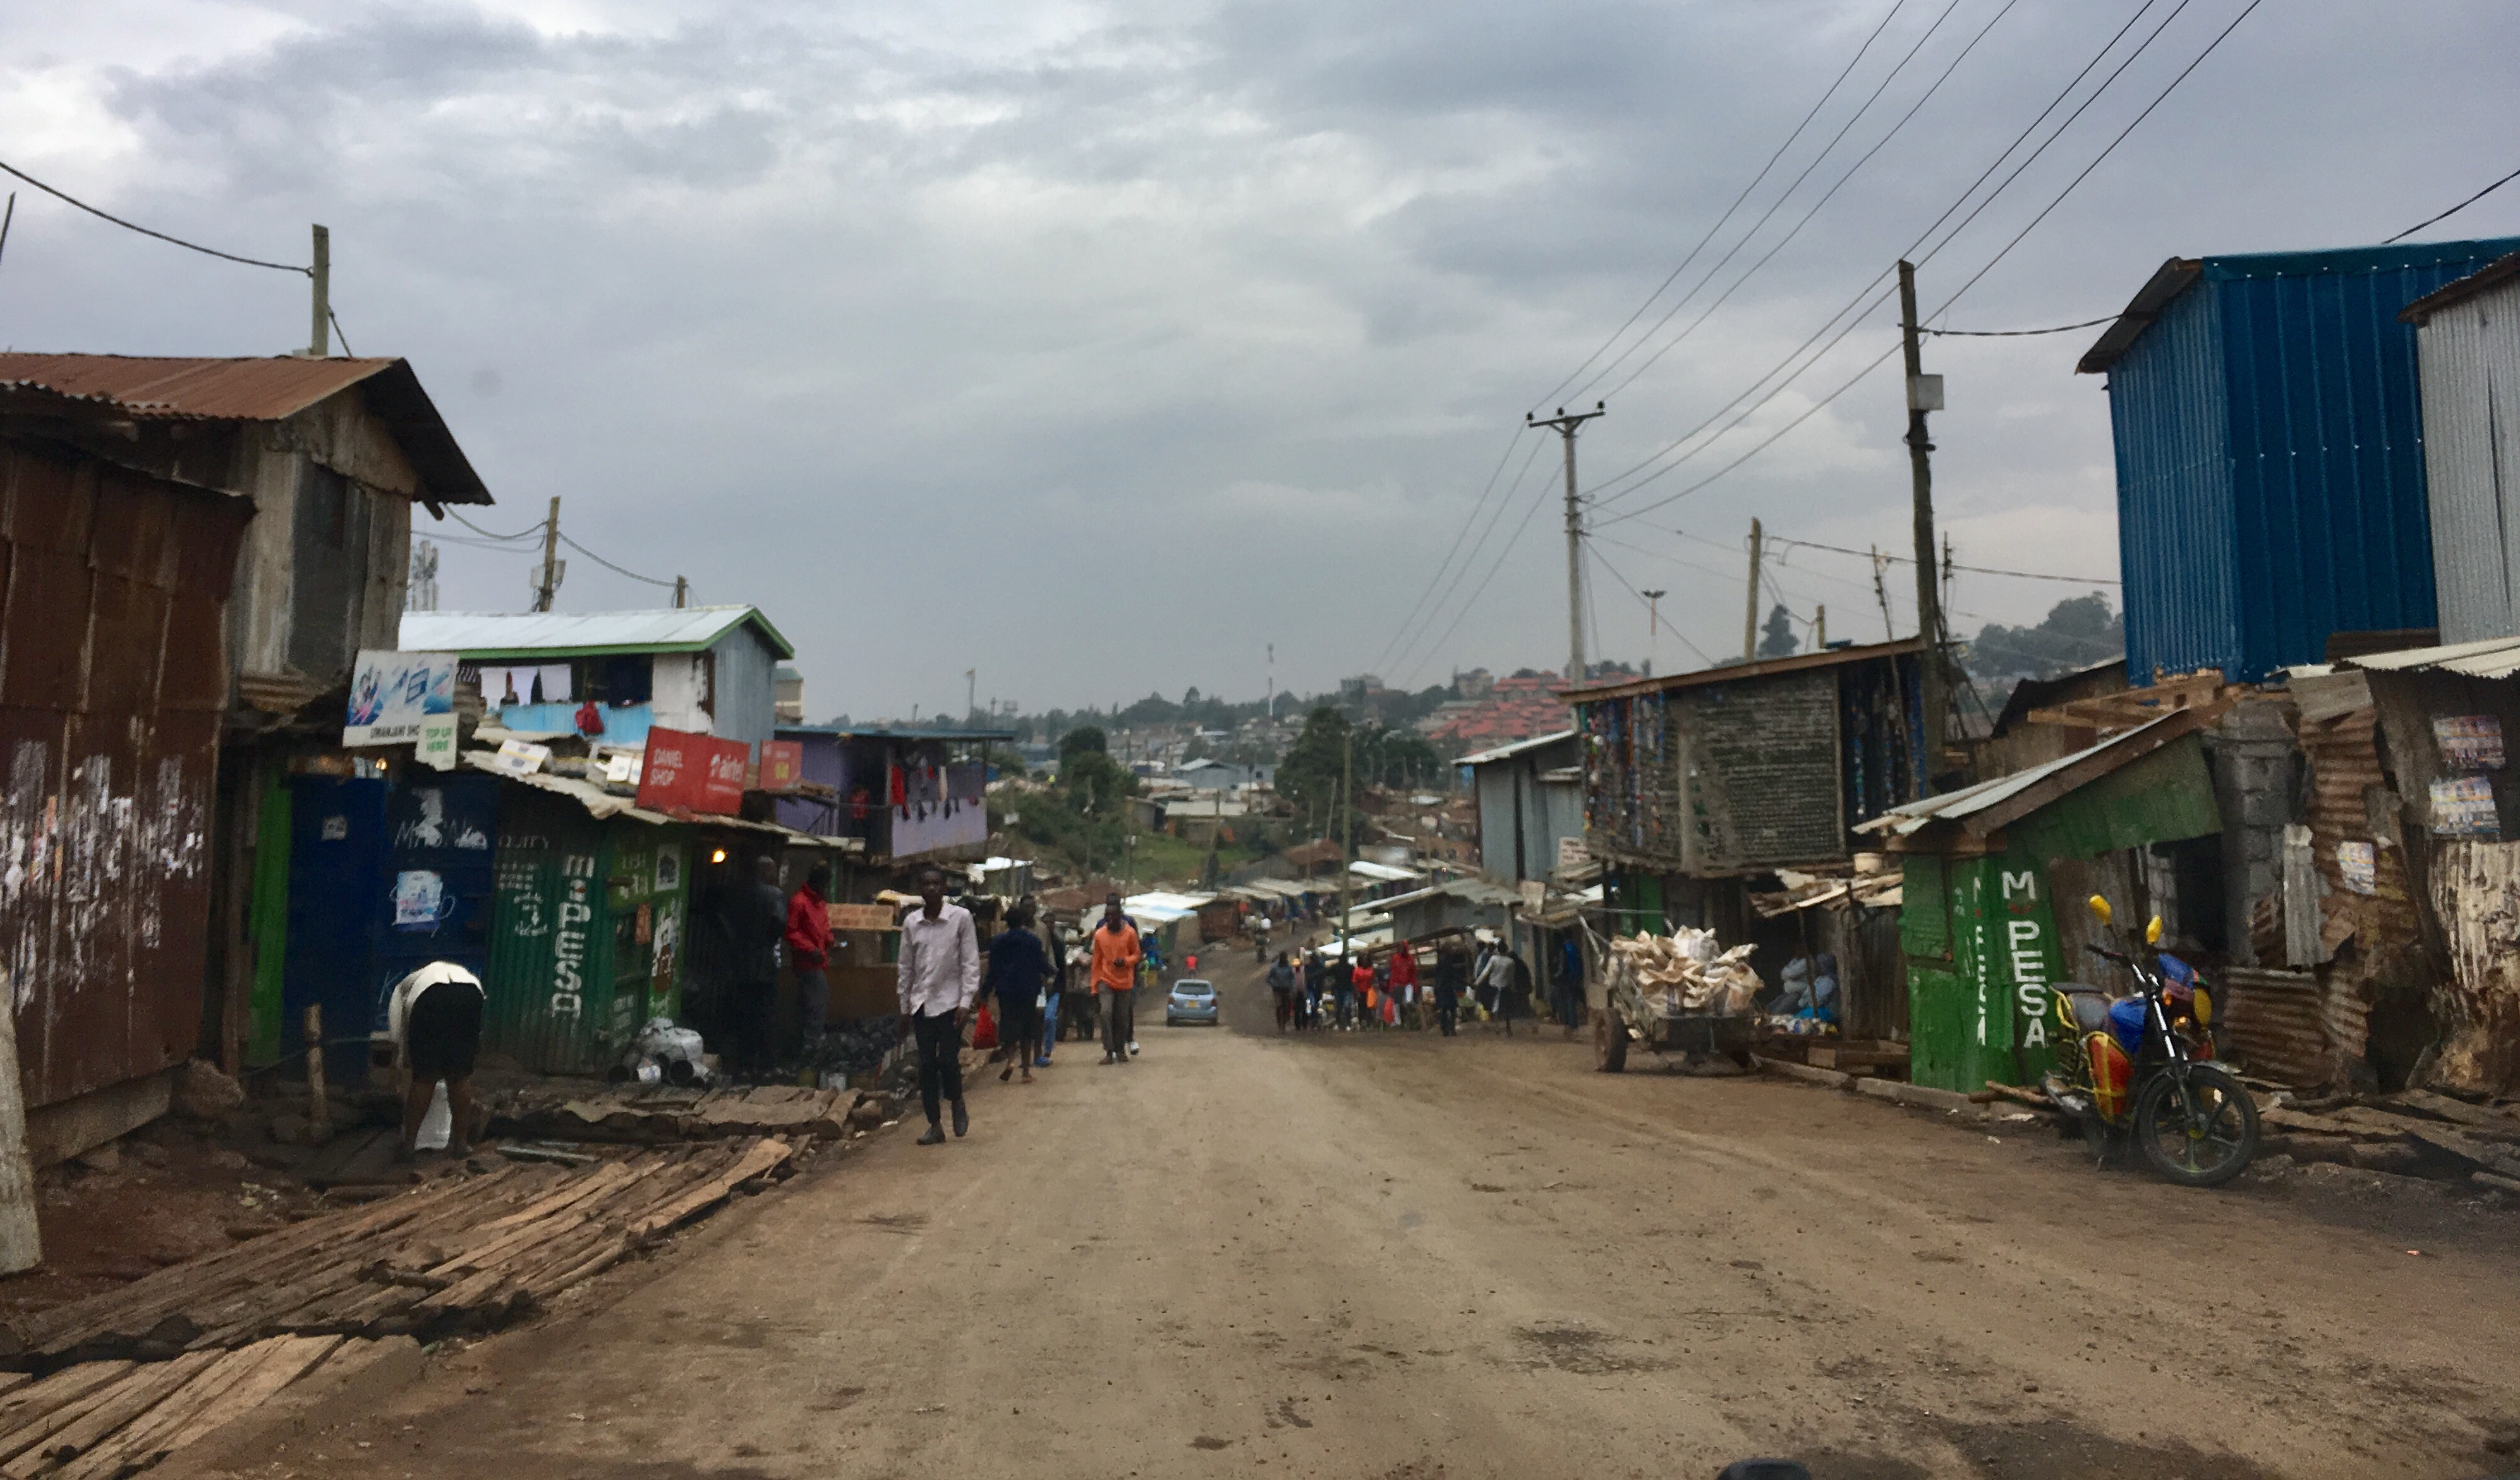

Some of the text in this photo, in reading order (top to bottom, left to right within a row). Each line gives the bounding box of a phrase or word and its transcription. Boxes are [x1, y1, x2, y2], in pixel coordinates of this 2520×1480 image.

[426, 727, 439, 737] TOP
[426, 740, 448, 752] HERE
[653, 748, 683, 768] DANIEL
[650, 770, 676, 787] SHOP
[2008, 920, 2049, 1049] PESA
